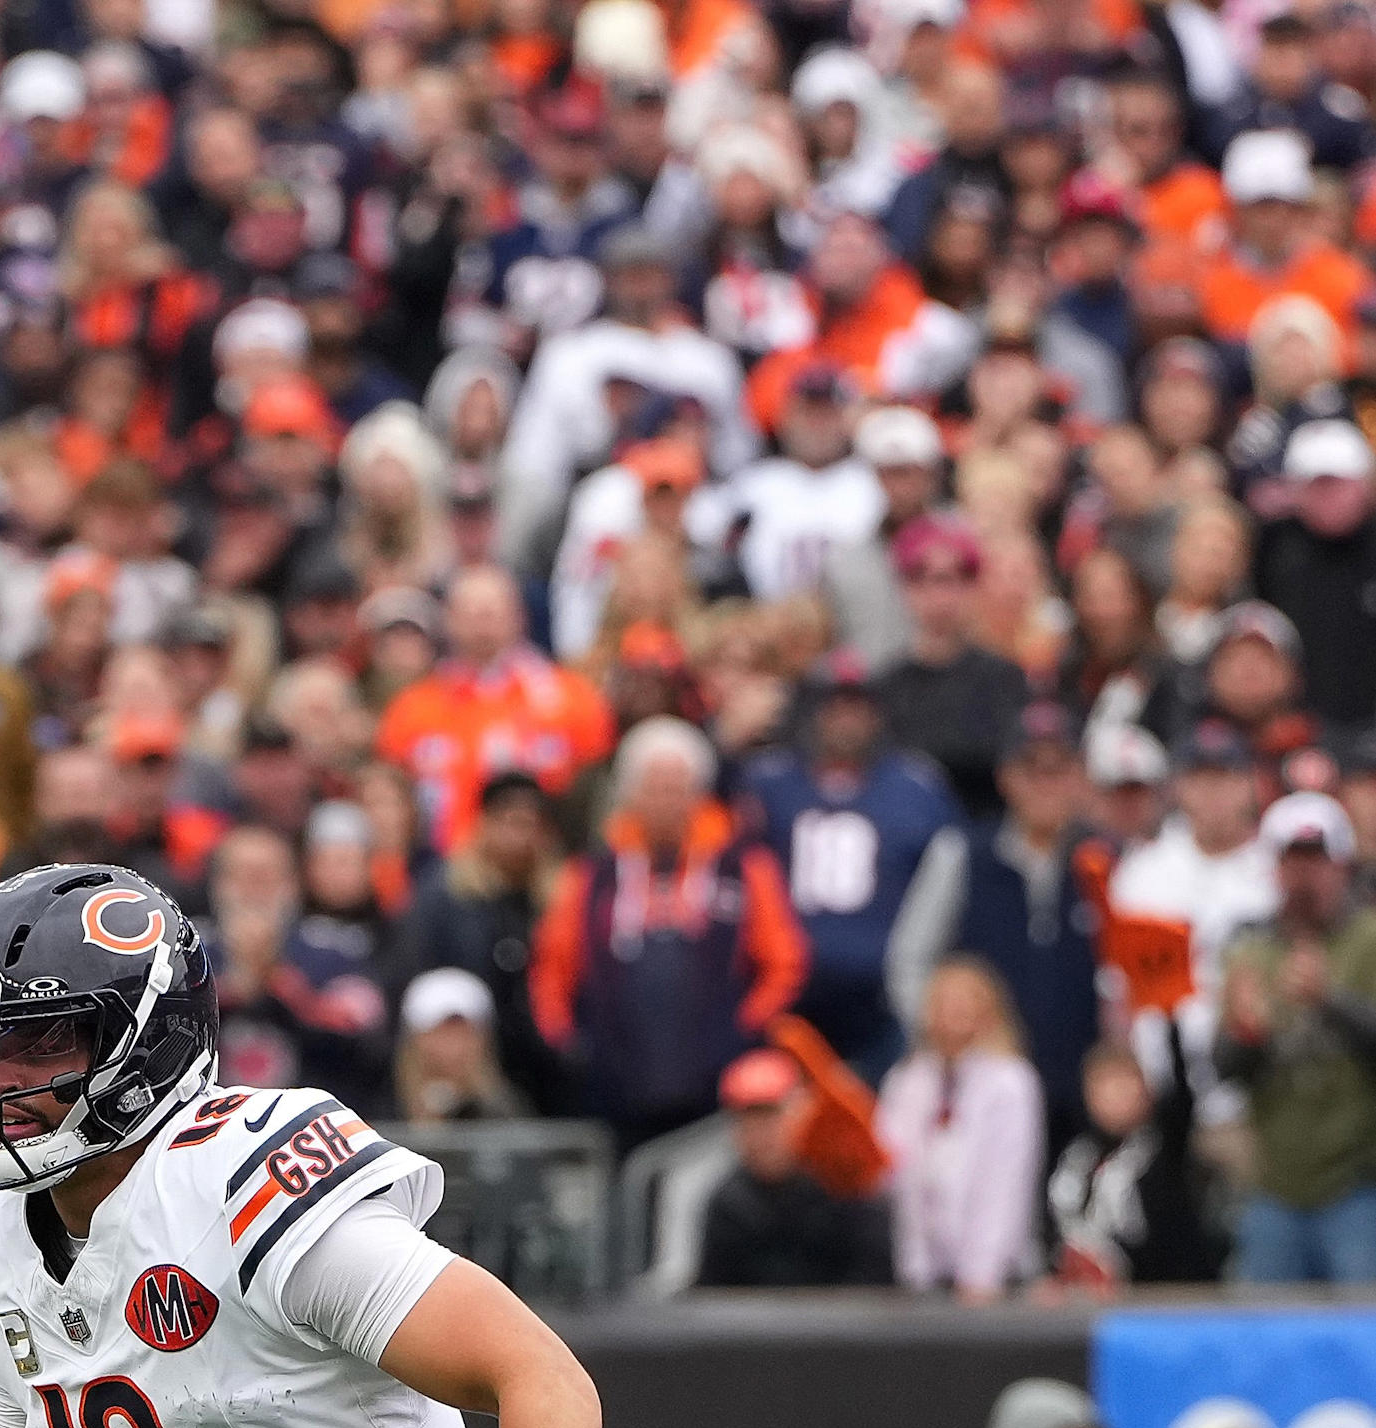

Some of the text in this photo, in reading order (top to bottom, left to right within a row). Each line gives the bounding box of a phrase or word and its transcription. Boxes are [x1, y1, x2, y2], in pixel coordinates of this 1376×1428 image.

[82, 888, 166, 955] C
[21, 990, 68, 999] OAKLEY
[168, 1093, 250, 1150] 18
[265, 1114, 356, 1198] GSH
